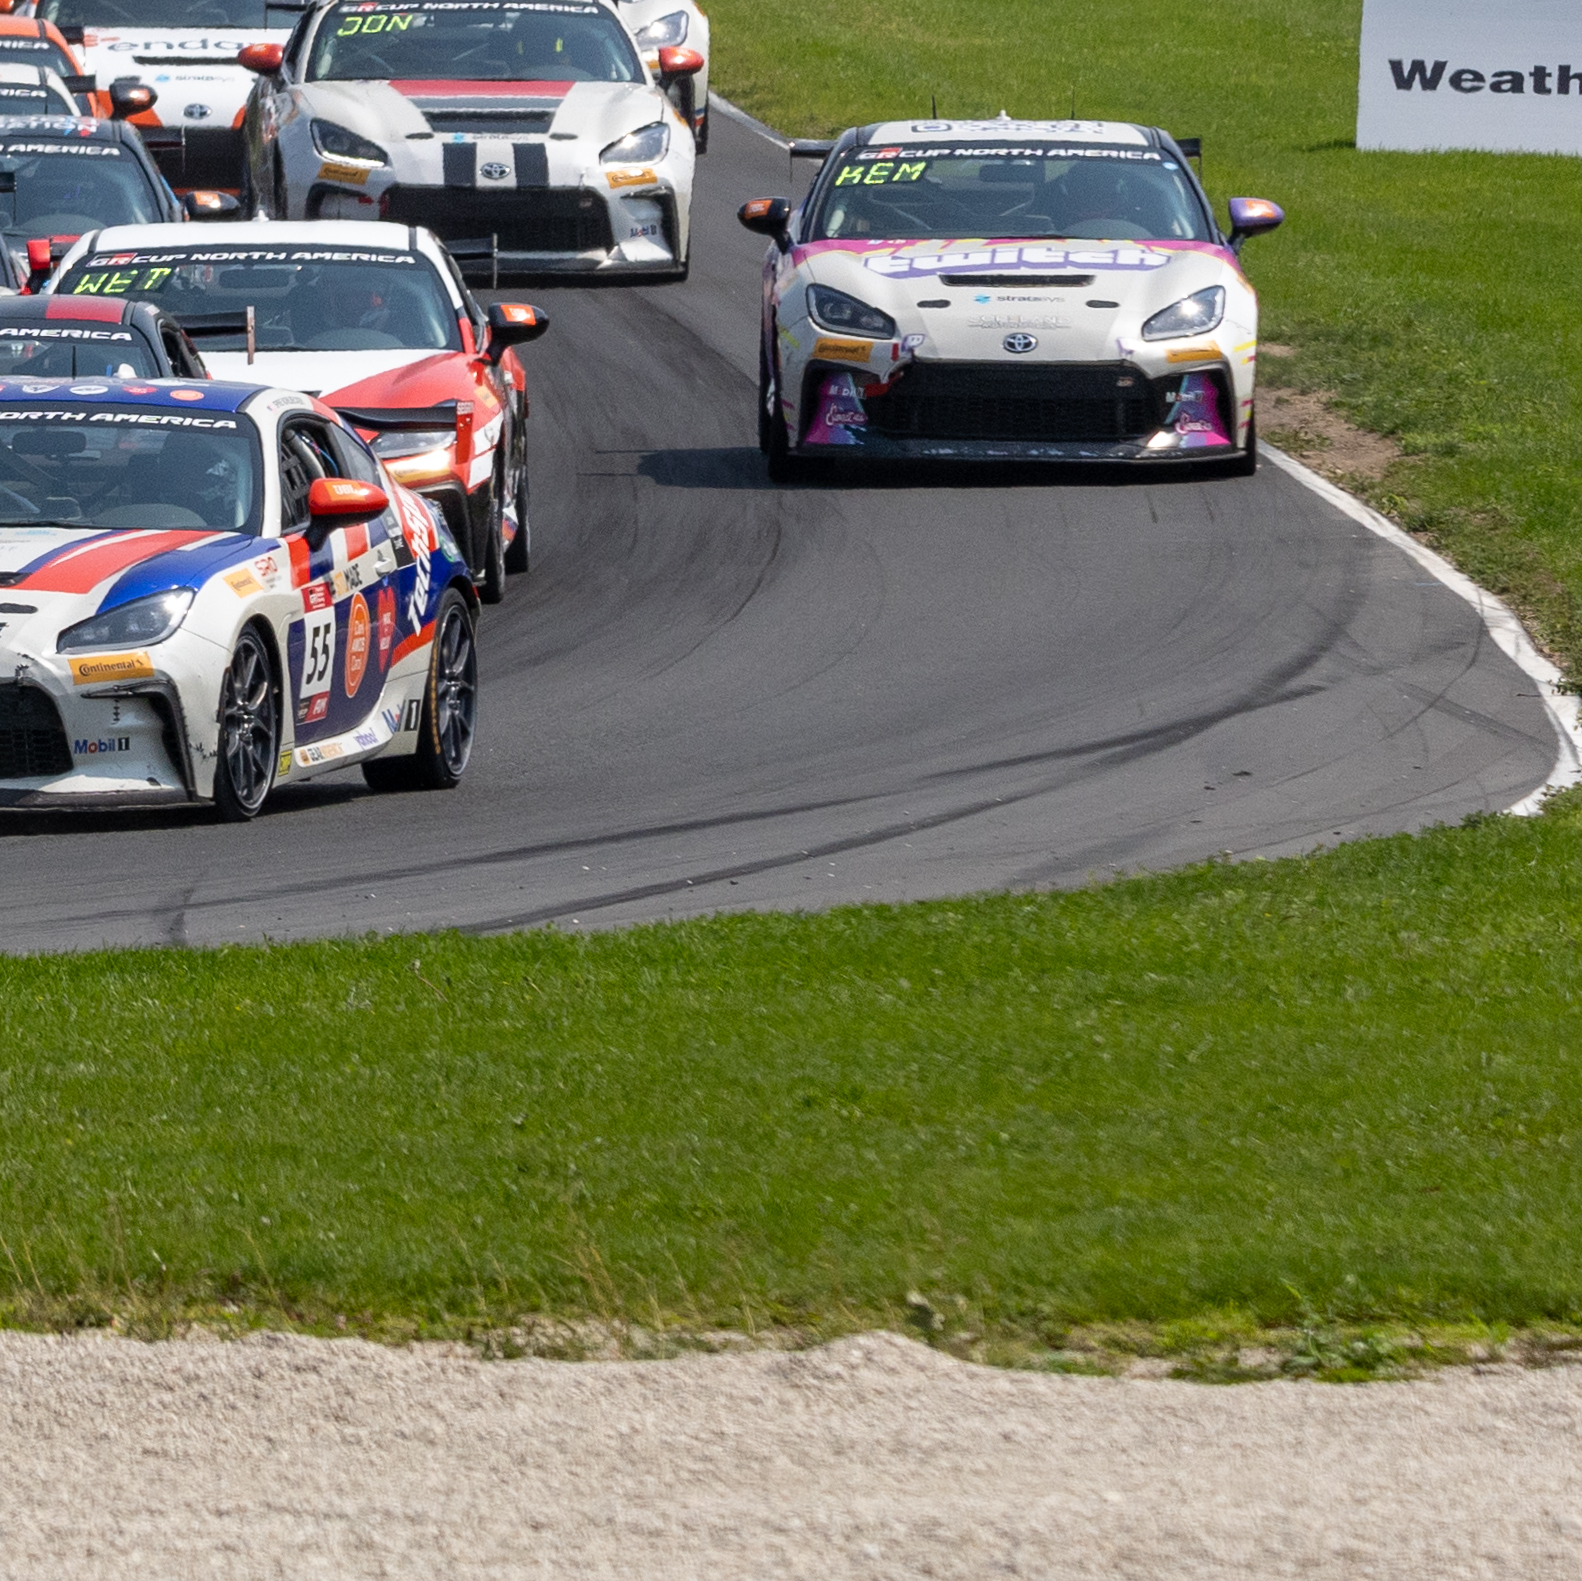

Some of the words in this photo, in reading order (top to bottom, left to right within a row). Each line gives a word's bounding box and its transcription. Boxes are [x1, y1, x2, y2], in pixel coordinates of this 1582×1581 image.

[374, 2, 421, 12] CUP
[424, 2, 501, 11] NORTH
[503, 2, 599, 15] AMERICA
[337, 14, 413, 37] JON
[2, 144, 121, 157] AMERICA
[898, 148, 951, 159] CUP
[952, 146, 1043, 157] NORTH
[1046, 147, 1162, 161] AMERICA
[130, 253, 188, 265] CUP
[190, 250, 288, 263] NORTH
[290, 251, 416, 265] AMERICA
[865, 247, 1171, 277] twitch
[93, 412, 238, 429] AMERICA
[305, 621, 333, 687] 55
[78, 659, 137, 677] Continental
[73, 738, 116, 755] Mobil
